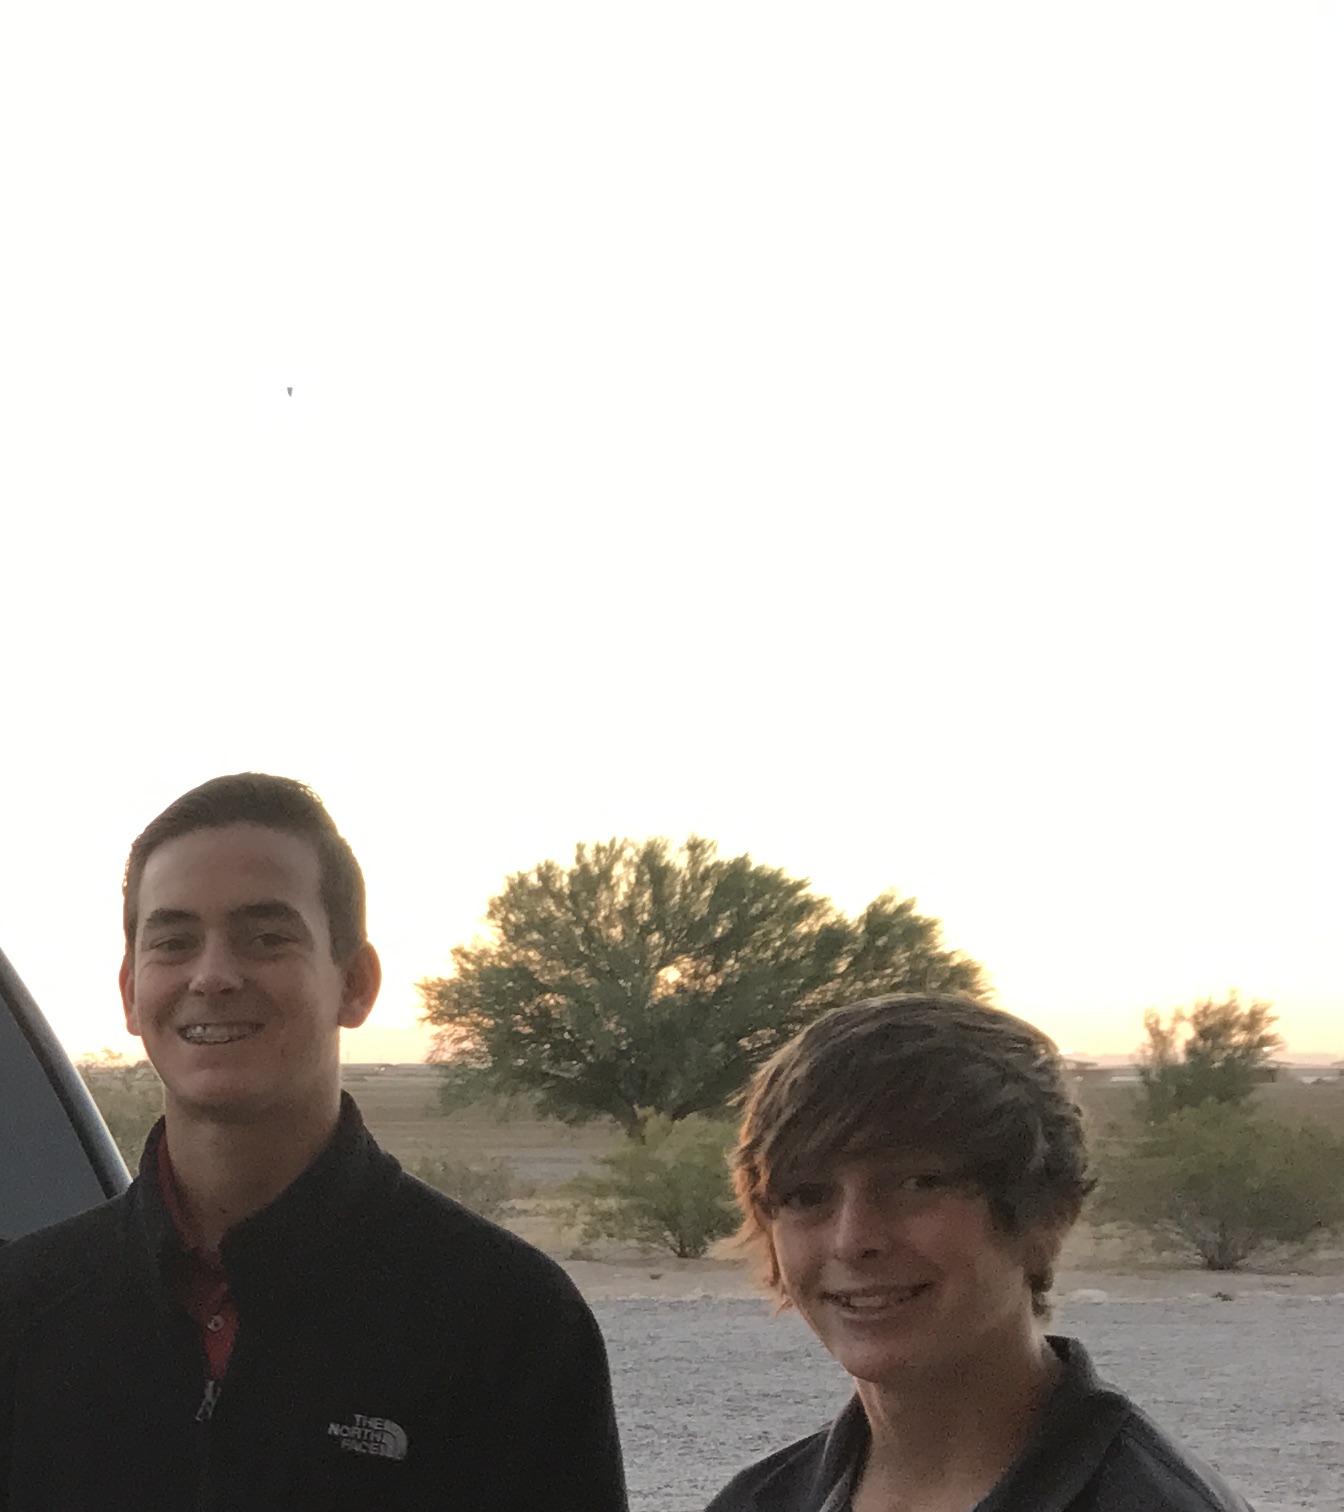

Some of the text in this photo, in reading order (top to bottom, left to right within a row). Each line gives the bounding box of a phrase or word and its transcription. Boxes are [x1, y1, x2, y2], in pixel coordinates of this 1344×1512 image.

[354, 1413, 384, 1430] THE
[328, 1423, 384, 1443] NORTH
[340, 1439, 380, 1455] FACE
